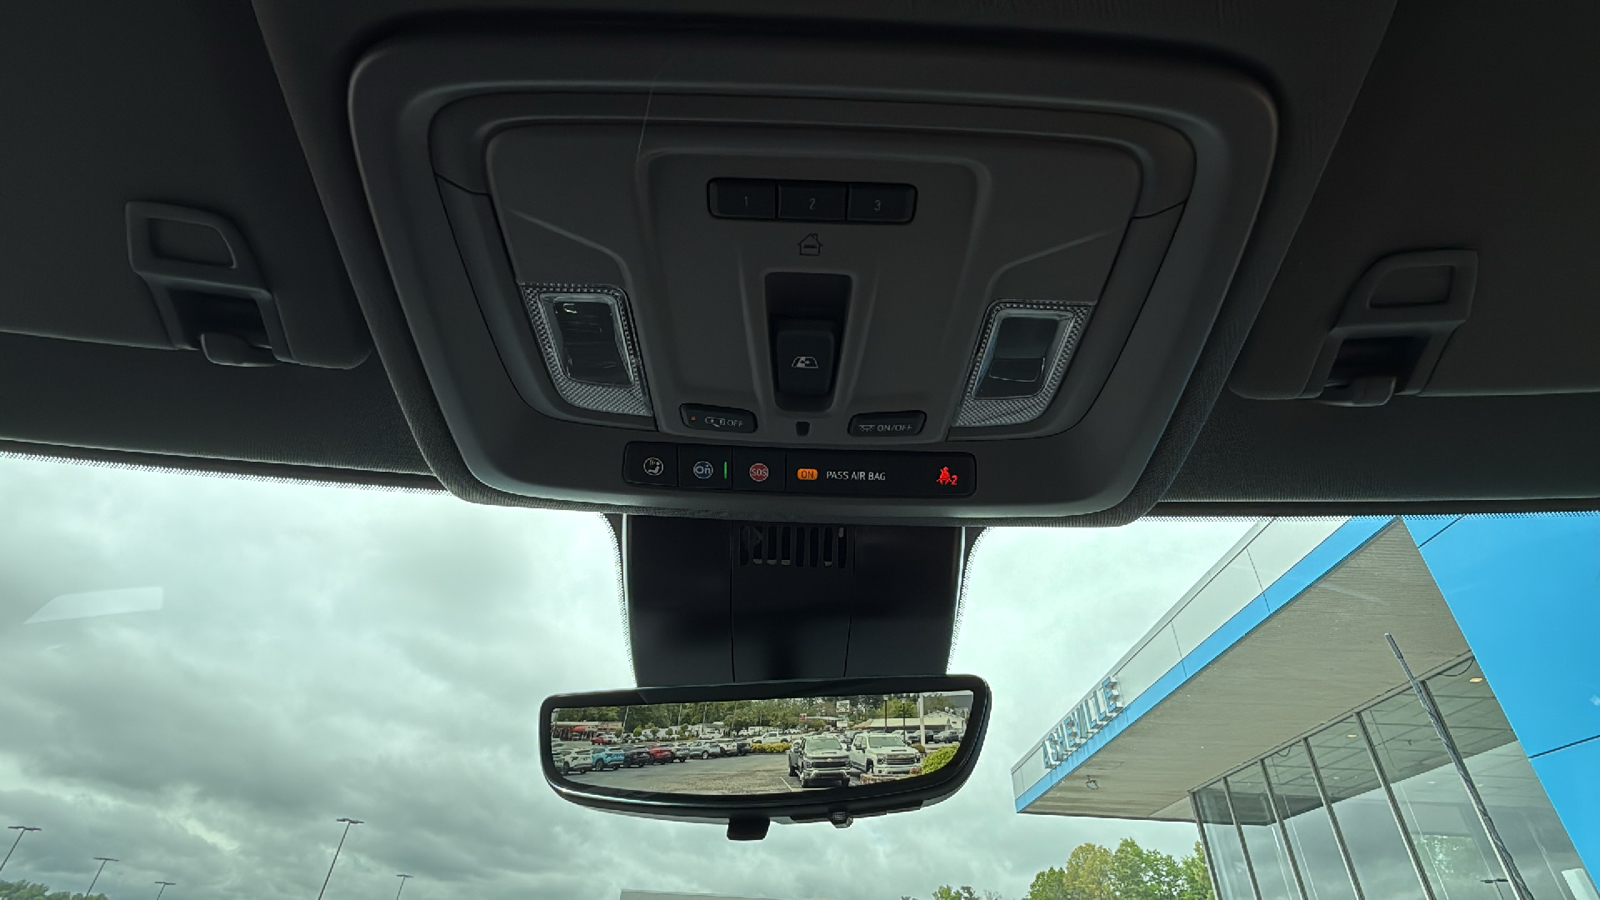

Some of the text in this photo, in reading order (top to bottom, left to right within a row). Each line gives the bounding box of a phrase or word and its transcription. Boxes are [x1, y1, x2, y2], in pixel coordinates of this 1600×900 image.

[809, 198, 816, 210] 2
[874, 200, 881, 211] 3
[727, 419, 744, 428] OFF
[877, 424, 913, 432] ON/OFF
[751, 466, 768, 477] SOS
[801, 470, 814, 479] ON
[826, 470, 886, 481] PASS AIR BAG
[950, 474, 959, 485] 2
[1042, 676, 1120, 769] ASHEVILLE
